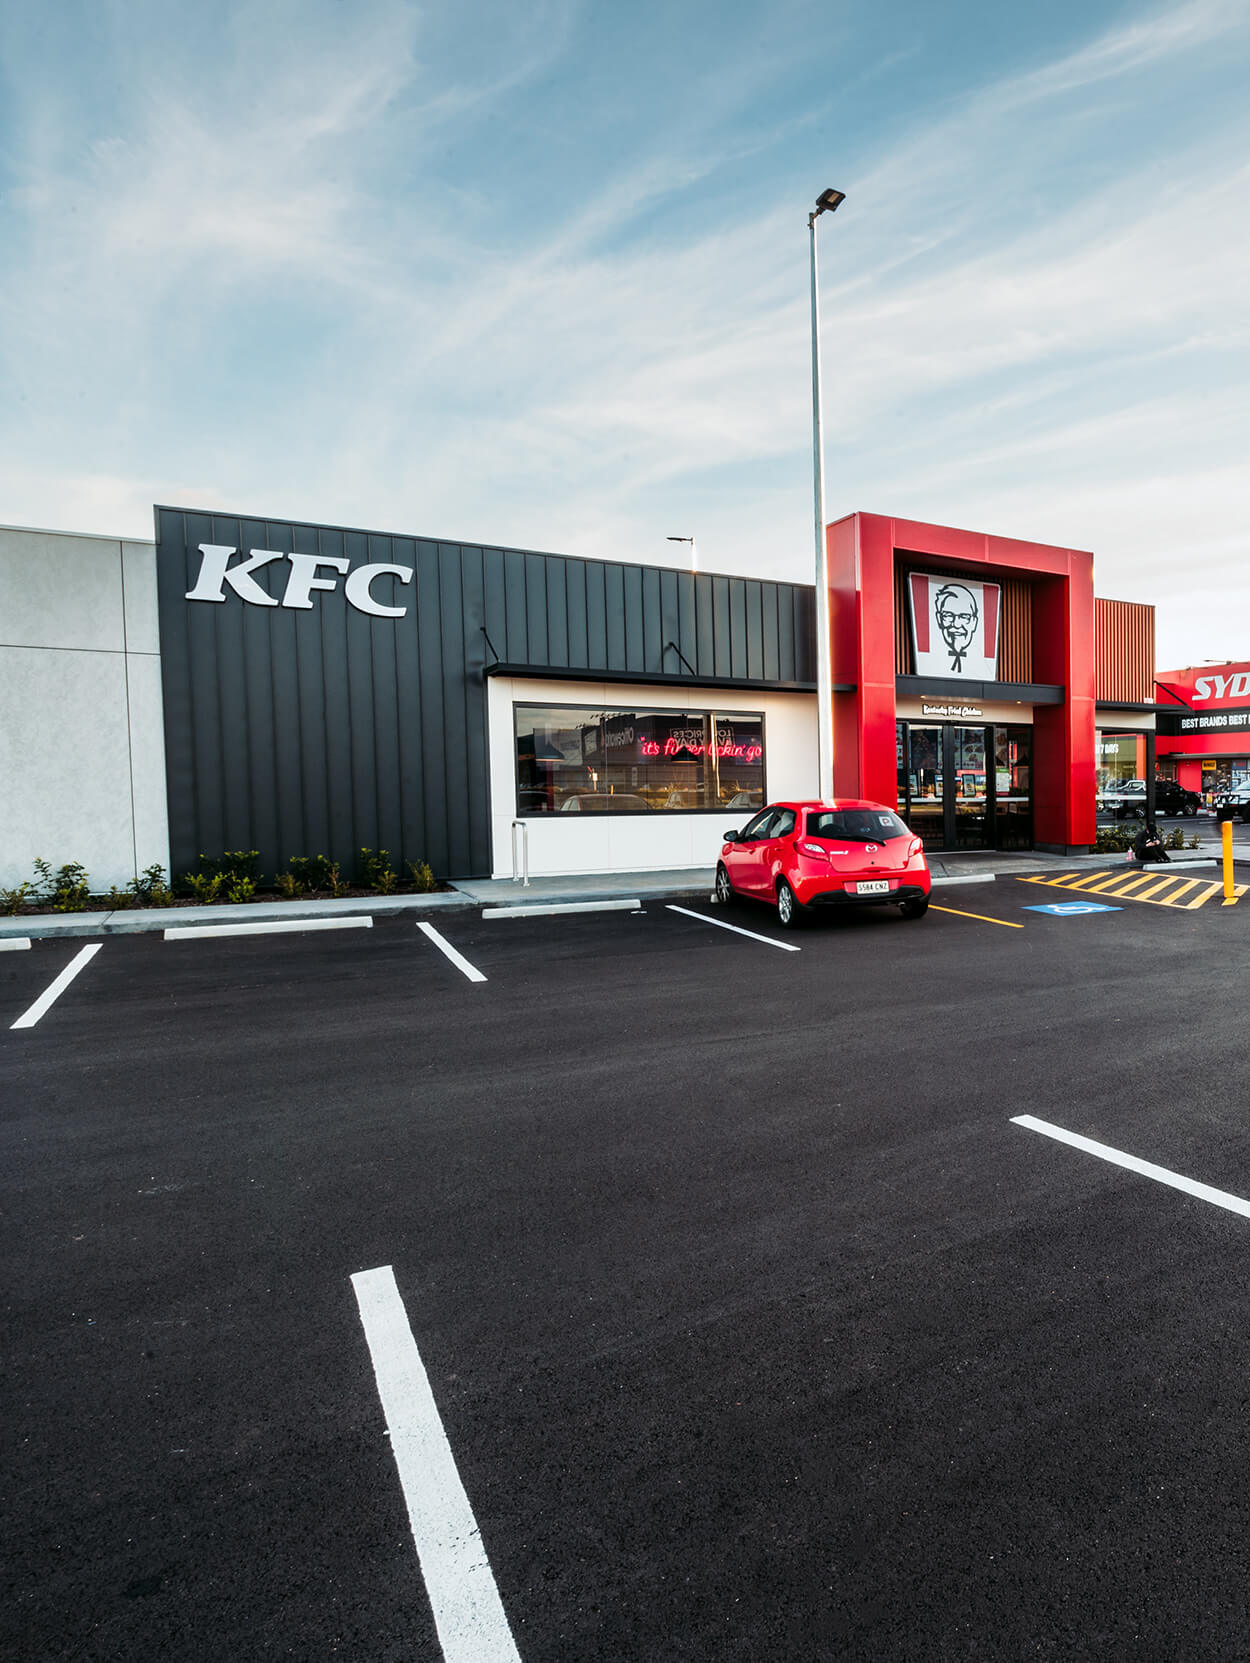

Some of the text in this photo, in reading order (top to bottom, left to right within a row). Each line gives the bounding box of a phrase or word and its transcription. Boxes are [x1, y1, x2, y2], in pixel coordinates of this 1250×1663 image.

[185, 544, 414, 618] KFC
[1181, 718, 1198, 729] BEST
[1200, 715, 1227, 728] BRANDS
[1229, 714, 1247, 726] BEST
